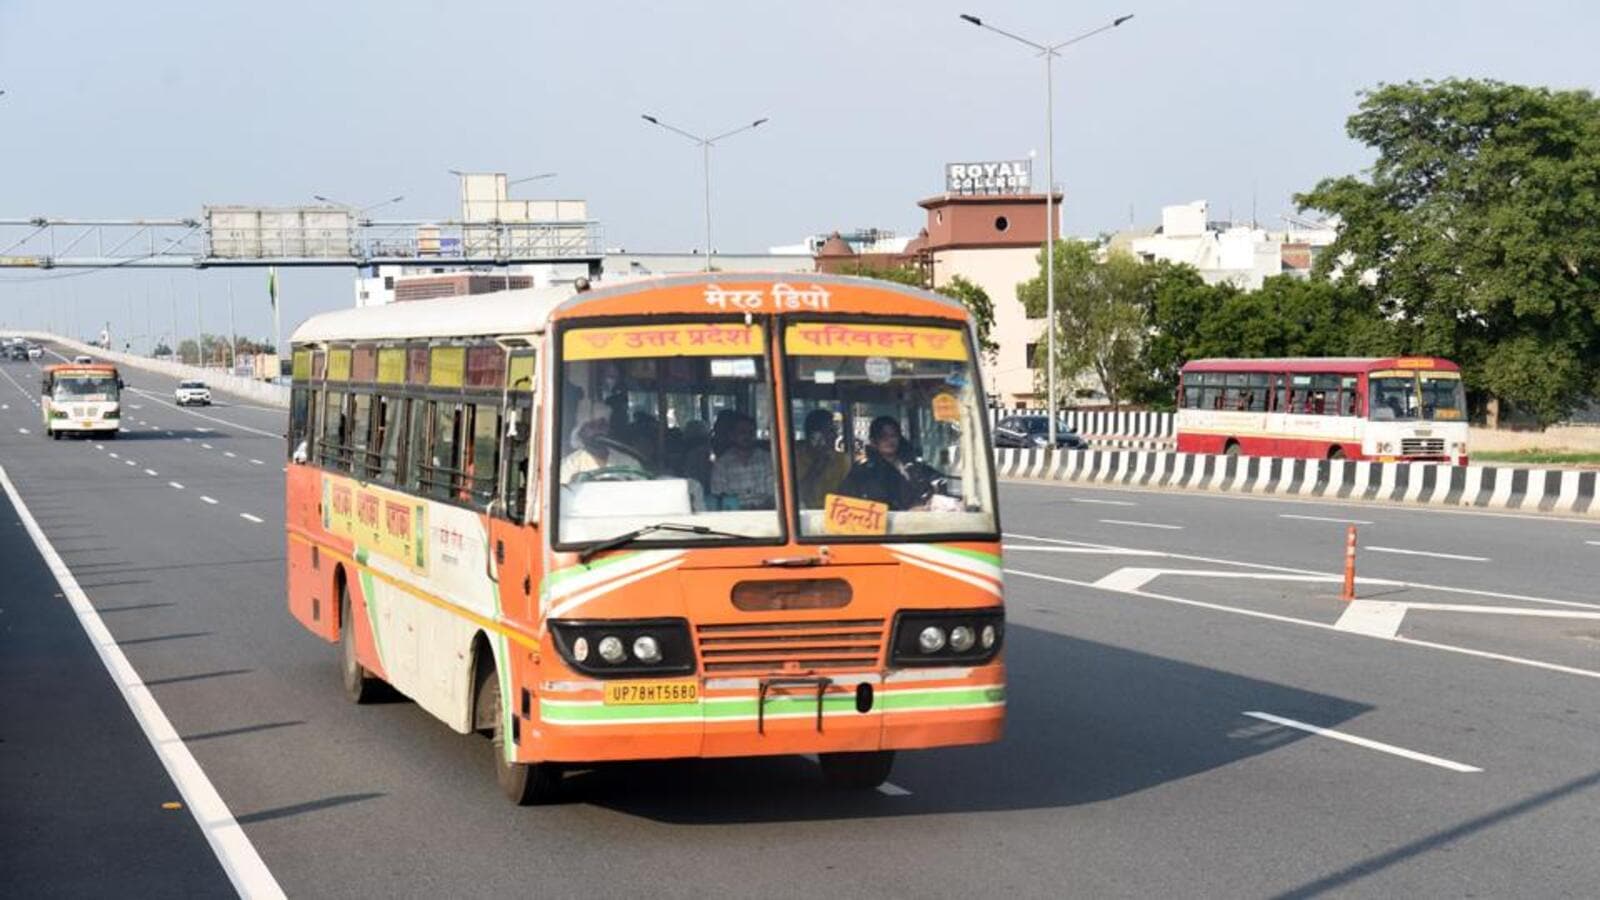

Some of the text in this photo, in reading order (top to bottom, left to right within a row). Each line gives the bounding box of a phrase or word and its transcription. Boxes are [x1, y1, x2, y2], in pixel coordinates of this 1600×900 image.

[951, 163, 1027, 178] ROYAL
[703, 283, 832, 310] मेरठ डिपो
[626, 324, 915, 348] उत्तर प्रदेश परिवहन
[831, 498, 883, 530] दिल्ली
[613, 684, 697, 701] UP78HT5680
